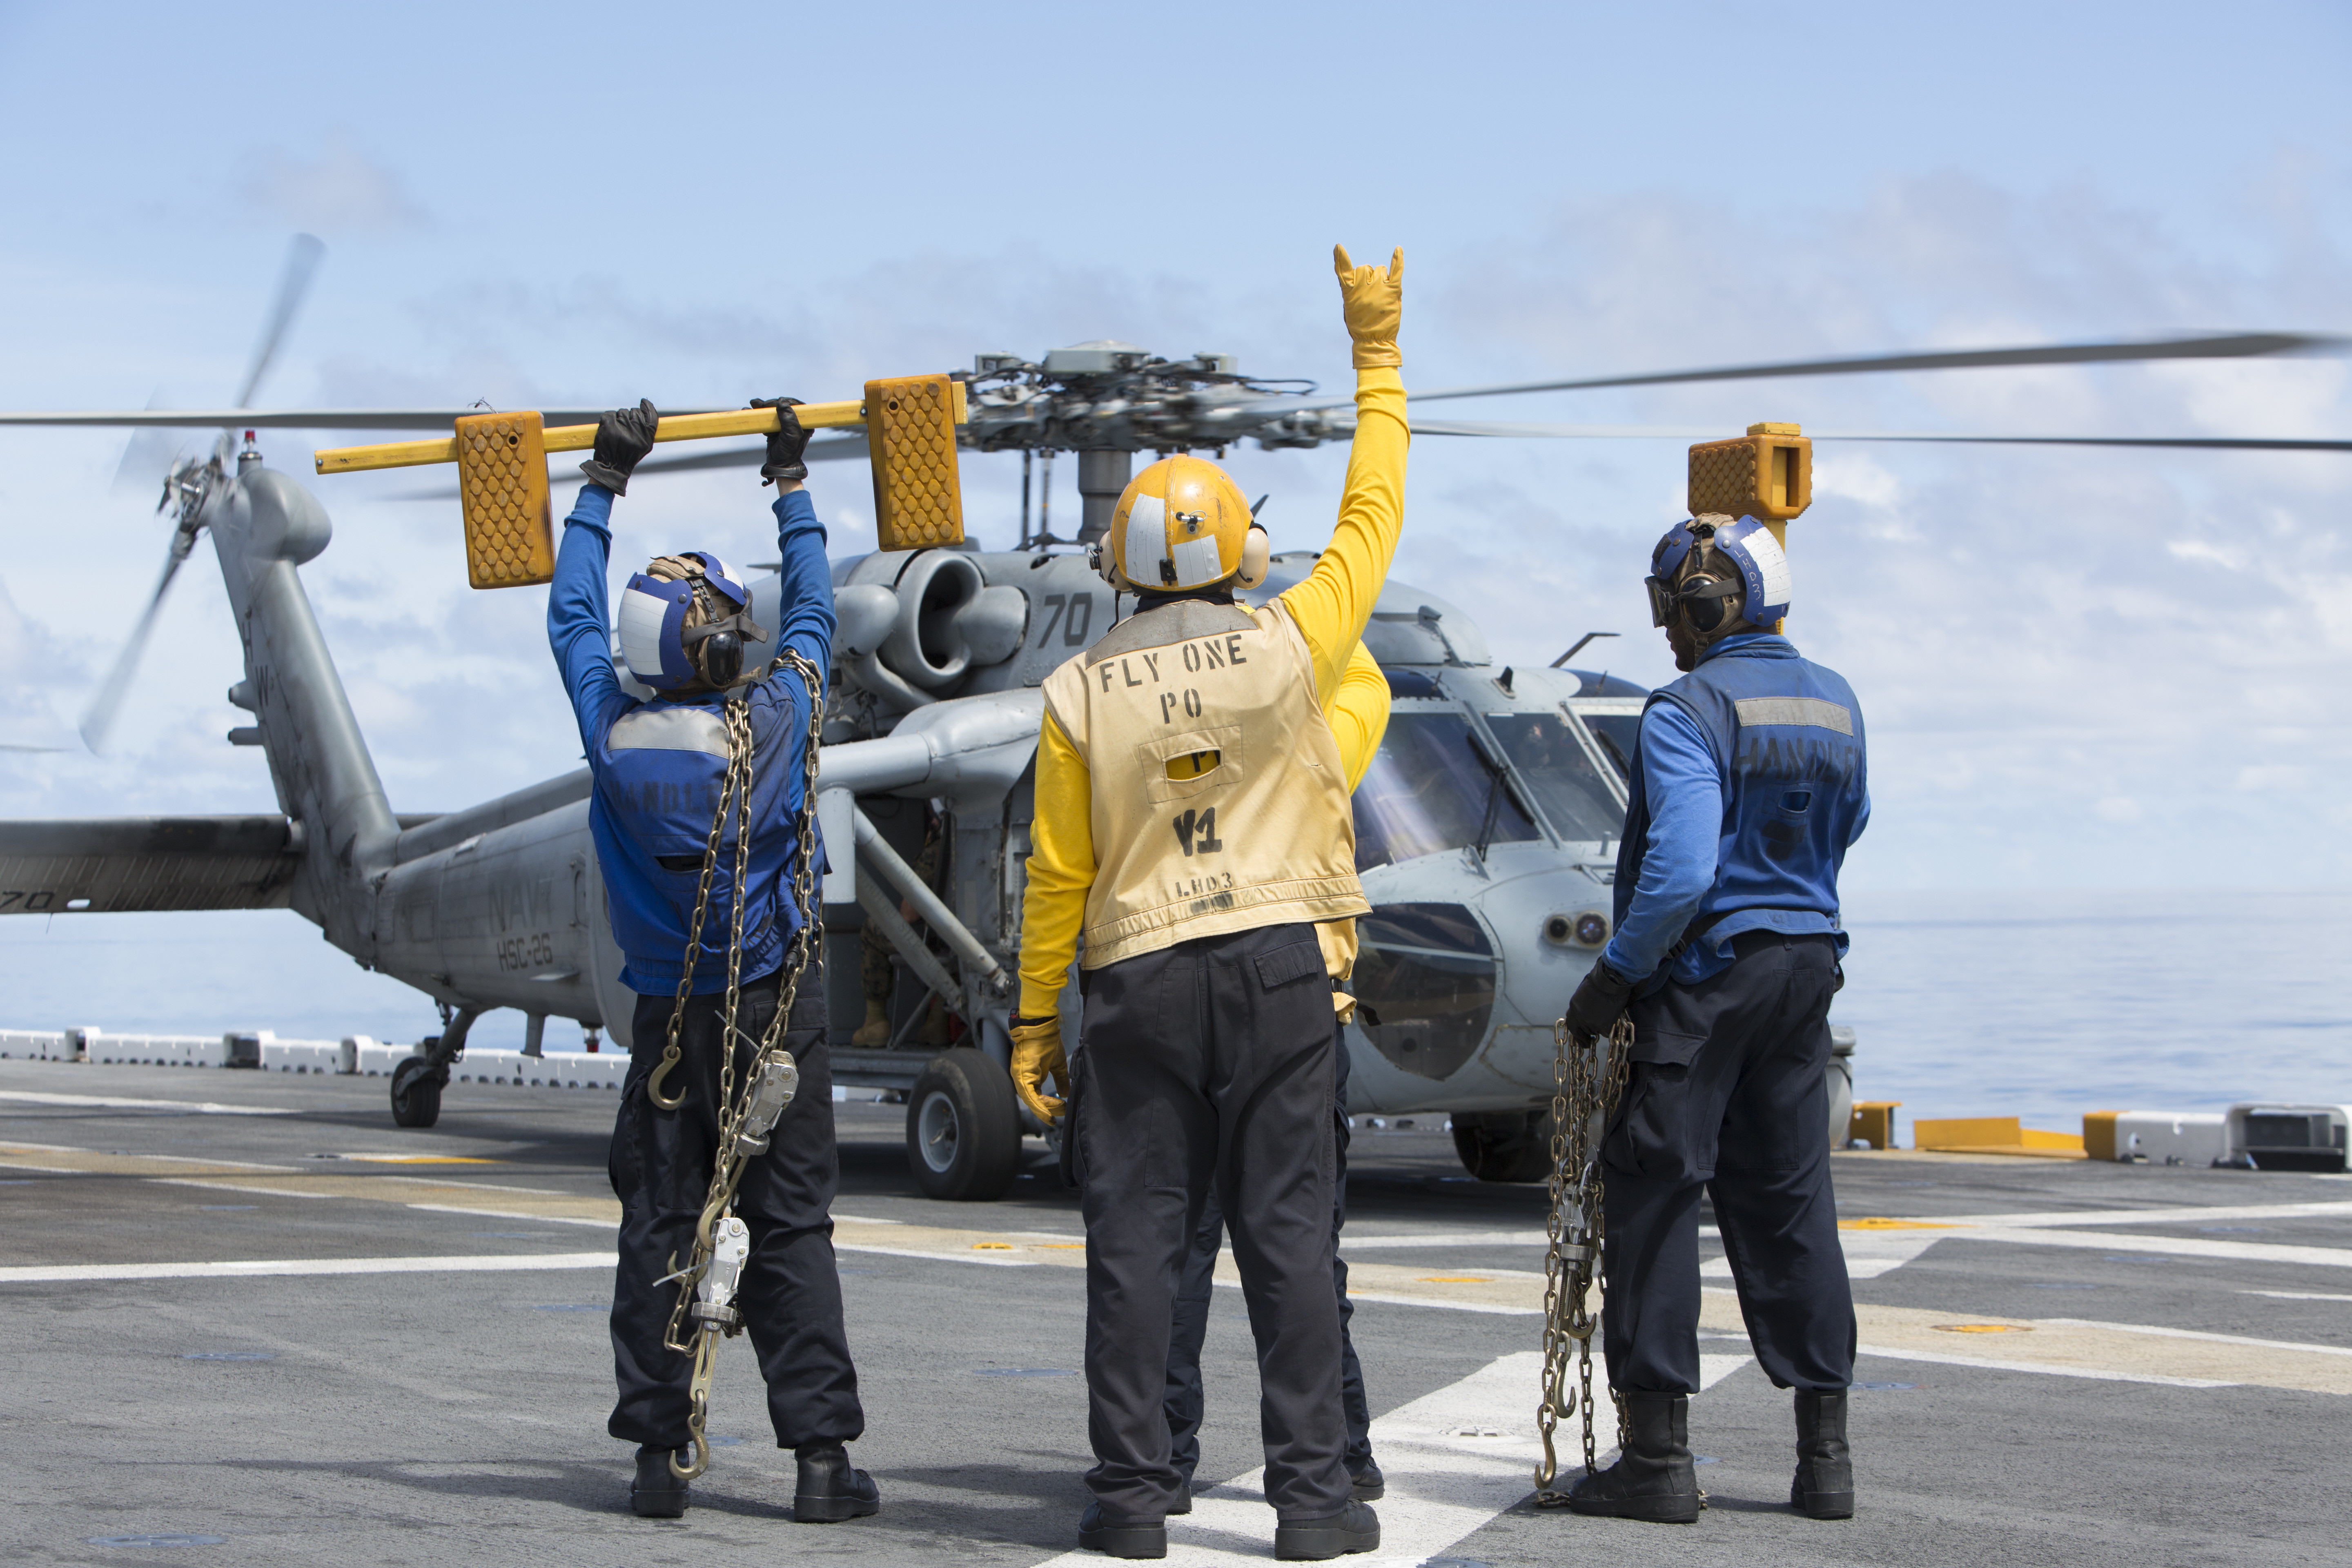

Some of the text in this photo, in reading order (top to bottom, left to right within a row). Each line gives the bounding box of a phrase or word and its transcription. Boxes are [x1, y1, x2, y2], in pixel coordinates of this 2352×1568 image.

[1734, 550, 1762, 600] LHD3
[1037, 592, 1093, 650] 70
[1099, 634, 1247, 693] FLY ONE
[1160, 688, 1202, 724] PO
[1172, 806, 1223, 857] V1
[0, 889, 56, 910] 70
[488, 872, 555, 934] NAVY
[497, 932, 553, 972] HSC-26
